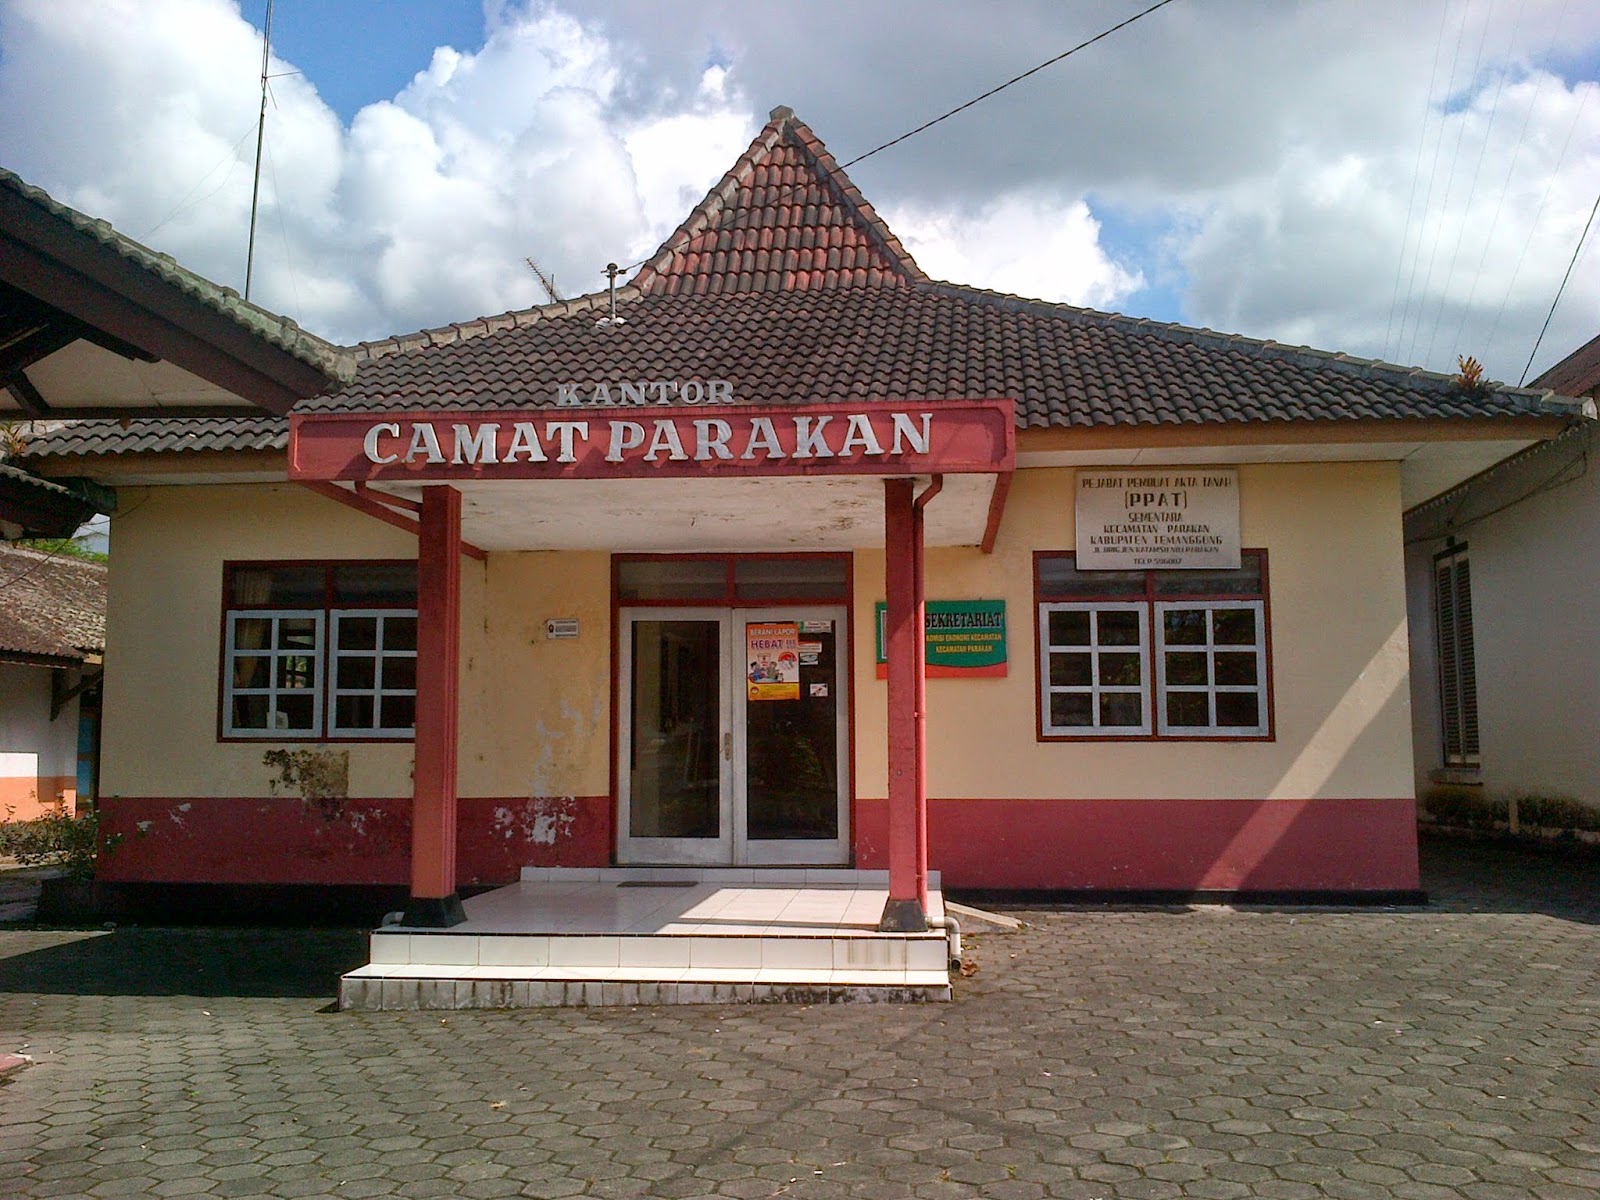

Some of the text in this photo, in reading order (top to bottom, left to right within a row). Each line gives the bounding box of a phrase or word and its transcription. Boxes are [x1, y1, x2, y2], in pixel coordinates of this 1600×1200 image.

[556, 380, 735, 407] KANTOR
[363, 413, 933, 465] CAMAT PARAKAN
[1082, 476, 1232, 488] PEJABAT PEMBUAT AKTA TANAH
[1128, 512, 1183, 523] SEMENTARA
[1103, 524, 1210, 534] KECAMATAN PARAKAN
[1090, 535, 1223, 545] KABUPATEN TEMANGGUNG
[925, 612, 1001, 629] SEKRETARIAT
[751, 639, 782, 649] HEBAT
